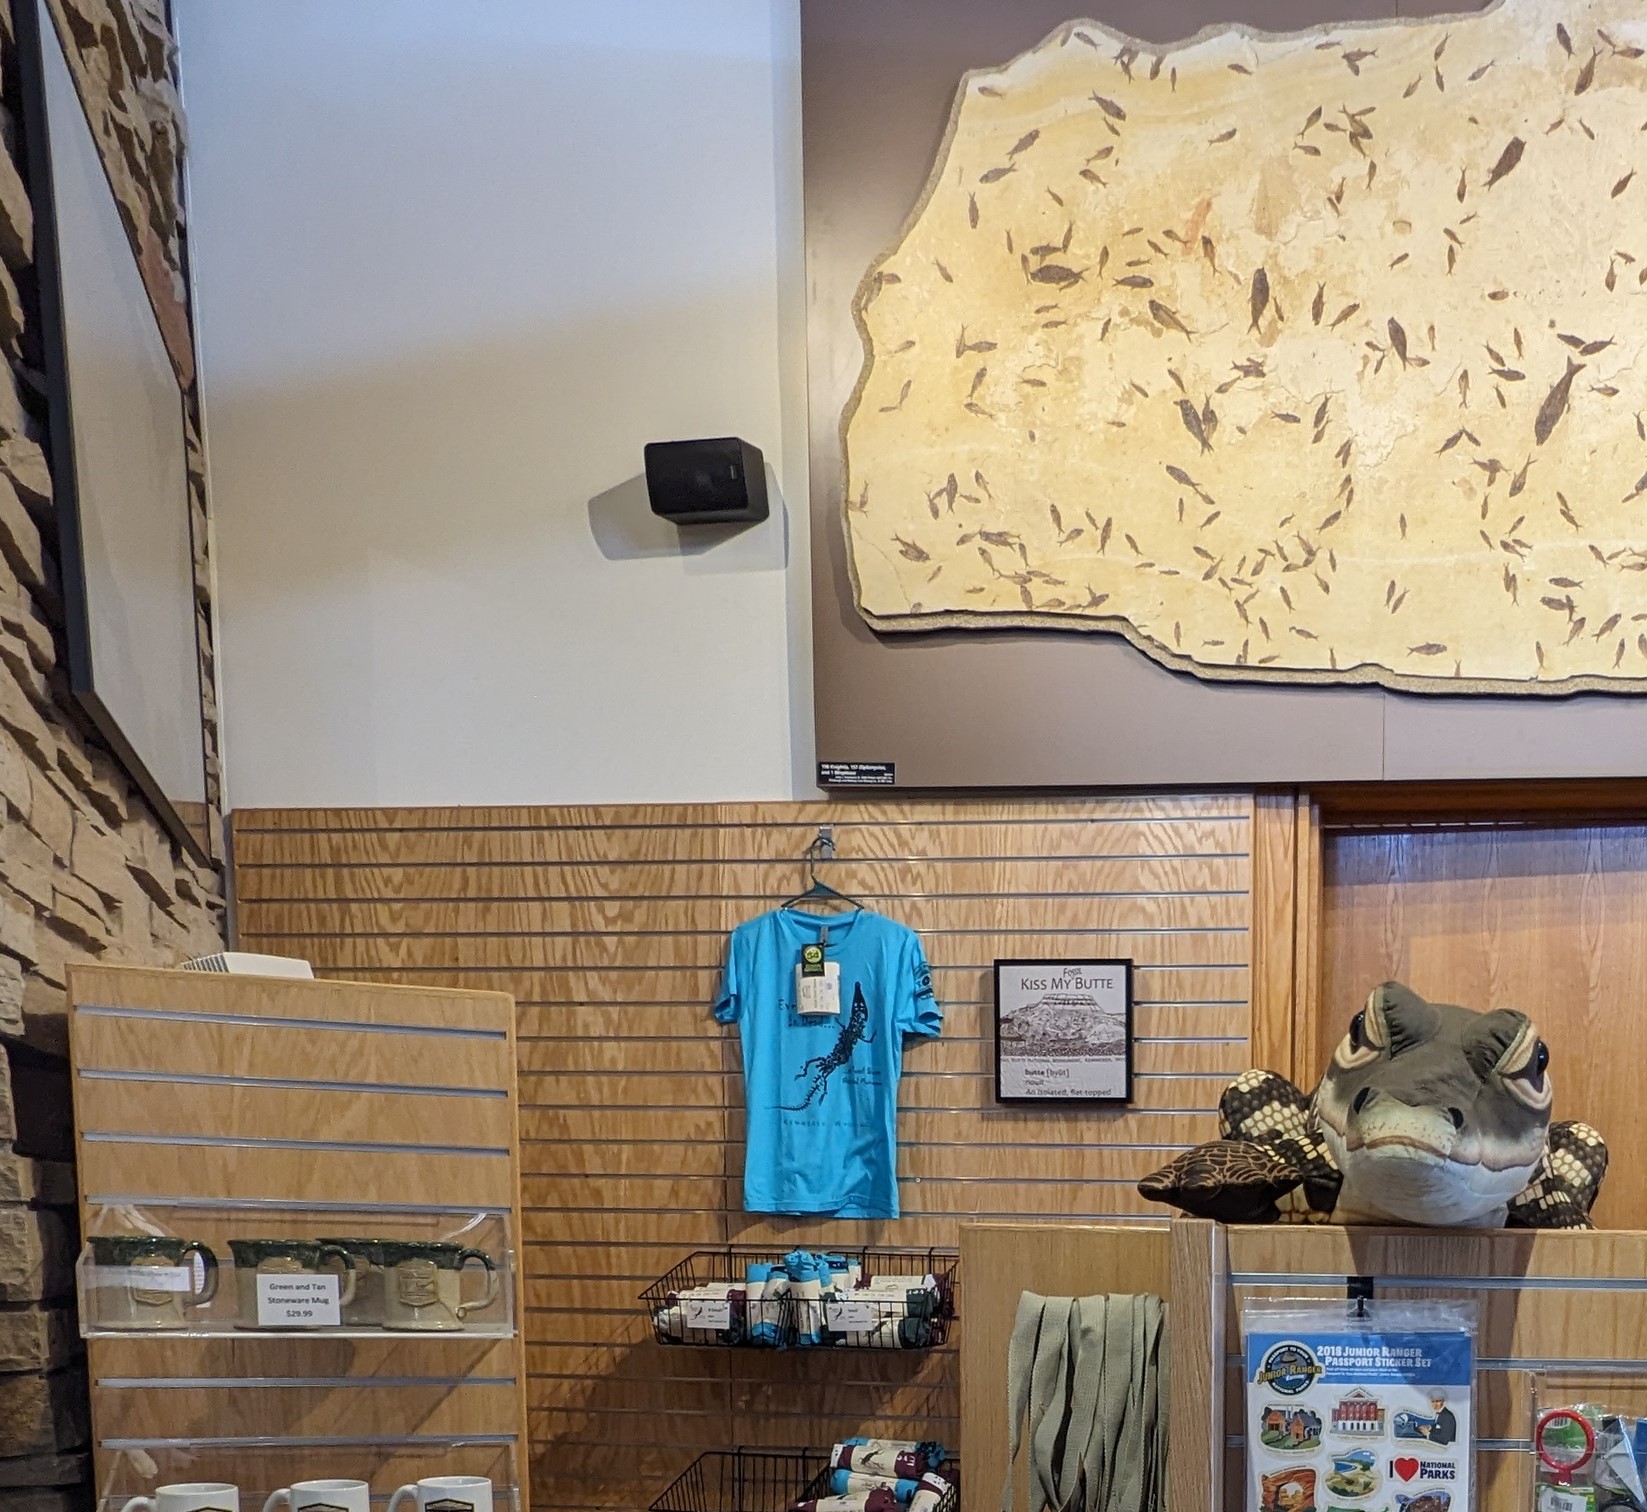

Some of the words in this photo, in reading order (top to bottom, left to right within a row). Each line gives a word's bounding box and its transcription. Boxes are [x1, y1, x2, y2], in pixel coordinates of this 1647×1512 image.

[1021, 978, 1047, 990] KISS
[1051, 978, 1071, 990] MY
[1075, 977, 1113, 989] BUTTE
[1317, 1346, 1341, 1356] 2018
[1343, 1347, 1380, 1357] JUNIOR
[1382, 1347, 1422, 1357] RANGER
[1325, 1357, 1374, 1366] PASSPORT
[1375, 1357, 1414, 1366] STICKER
[1415, 1359, 1432, 1367] SET
[1290, 1364, 1322, 1374] RANGER
[1420, 1461, 1455, 1470] NATIONAL
[1420, 1470, 1455, 1480] PARKS
